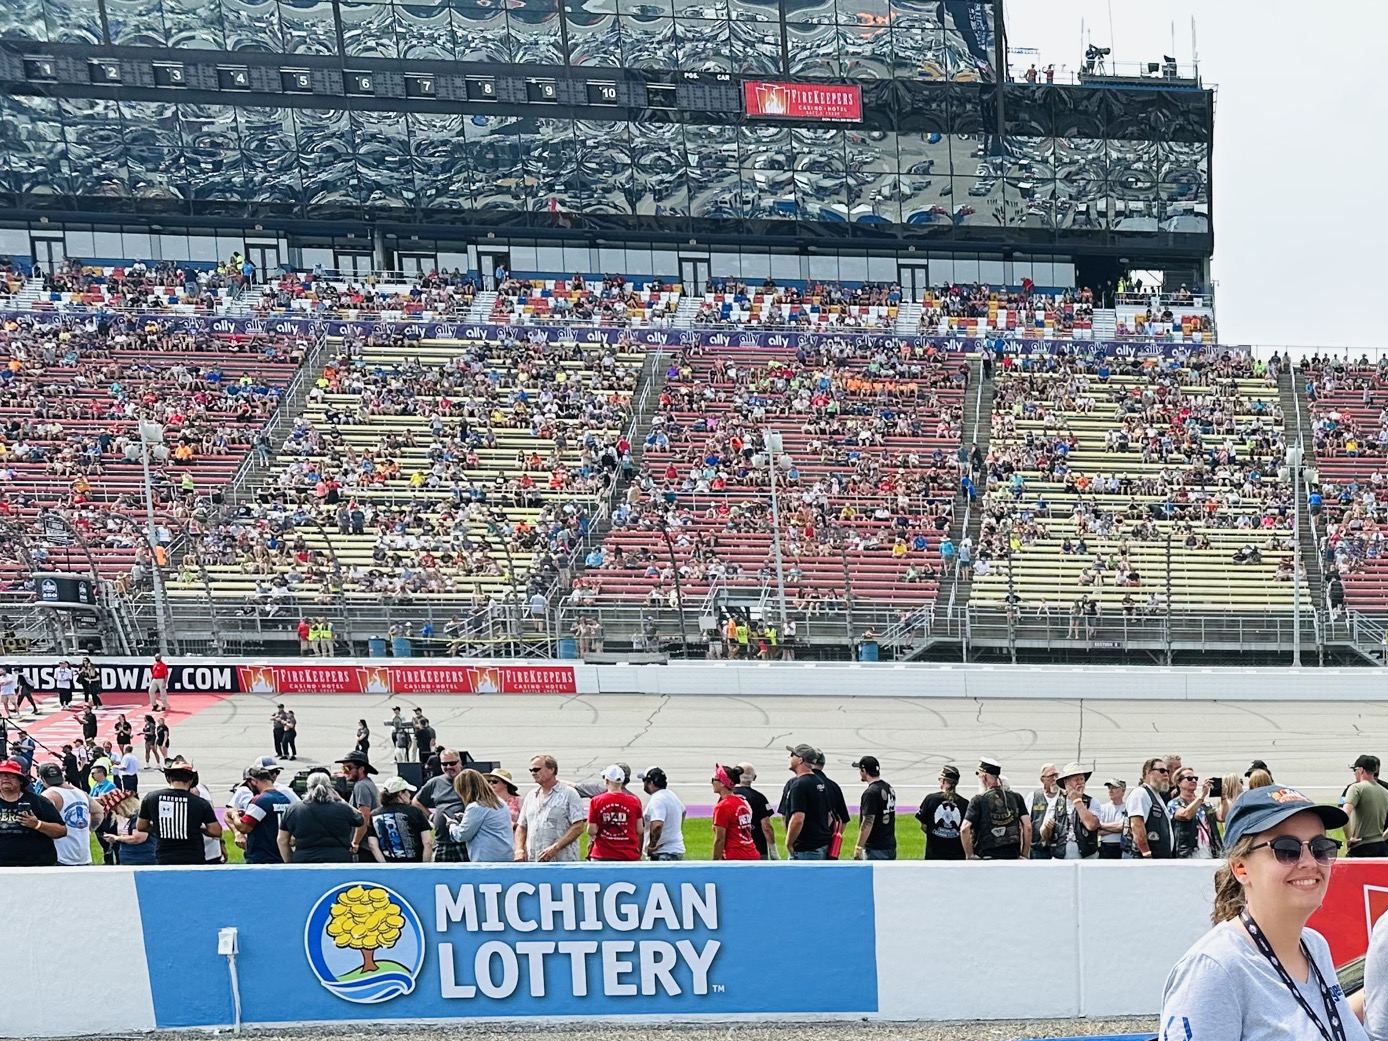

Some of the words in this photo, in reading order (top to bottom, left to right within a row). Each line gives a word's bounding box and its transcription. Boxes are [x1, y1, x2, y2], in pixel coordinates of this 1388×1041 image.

[44, 64, 51, 75] 1
[108, 67, 117, 78] 2
[173, 69, 181, 80] 3
[237, 73, 245, 84] 4
[300, 75, 308, 86] 5
[361, 78, 370, 89] 6
[422, 81, 431, 91] 7
[484, 83, 492, 94] 8
[545, 86, 553, 96] 9
[602, 87, 616, 98] 10
[791, 90, 853, 105] FIREKEEPERS
[213, 320, 235, 333] ally
[245, 319, 267, 331] ally
[276, 322, 298, 335] ally
[435, 323, 457, 336] ally
[466, 327, 487, 340] ally
[558, 327, 578, 339] ally
[587, 330, 609, 344] ally
[647, 332, 668, 344] ally
[709, 333, 730, 346] ally
[739, 333, 760, 344] ally
[768, 335, 789, 347] ally
[1031, 340, 1052, 351] ally
[1116, 346, 1136, 358] ally
[280, 668, 350, 683] FIREKEEPERS
[396, 668, 463, 683] FIREKEEPERS
[507, 668, 573, 683] FIREKEEPERS
[158, 795, 188, 803] FREEDOM
[435, 882, 717, 932] MICHIGAN
[439, 940, 721, 999] LOTTERY
